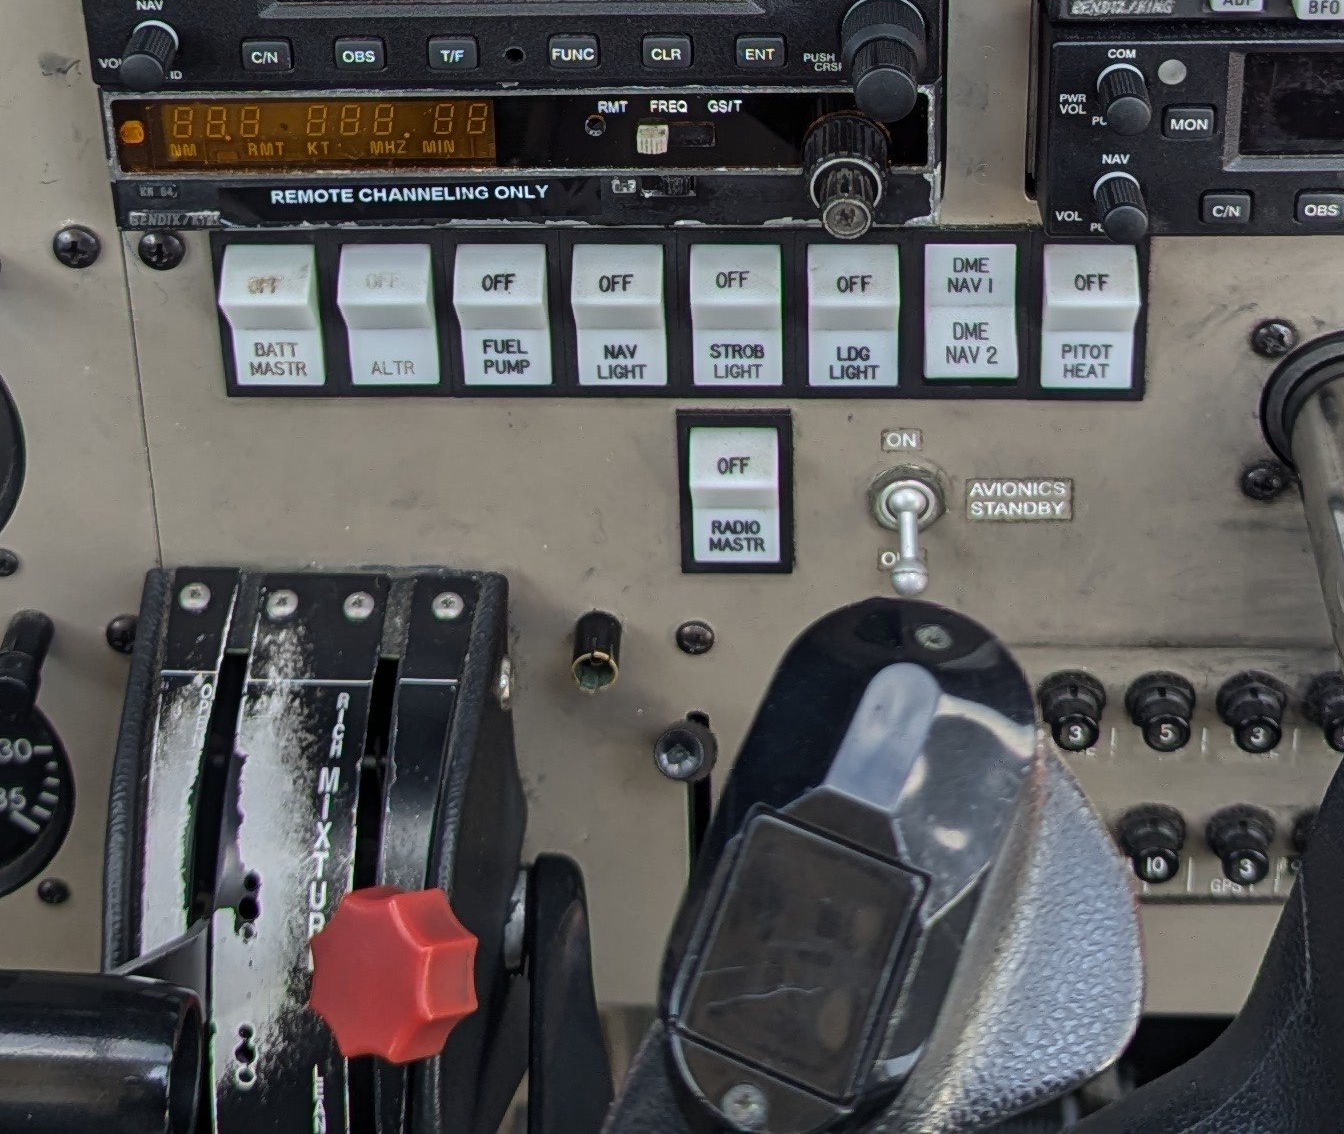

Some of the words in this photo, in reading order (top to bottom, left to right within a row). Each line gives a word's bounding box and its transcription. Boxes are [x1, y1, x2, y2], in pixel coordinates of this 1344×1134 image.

[1308, 0, 1340, 16] BFO
[251, 51, 279, 64] C/N
[342, 49, 376, 63] OBS
[597, 100, 629, 114] RMT
[649, 100, 688, 114] FREQ
[271, 187, 355, 205] REMOTE
[359, 186, 489, 203] CHANNELING
[494, 185, 549, 200] ONLY
[481, 273, 516, 292] OFF
[953, 323, 990, 341] DME
[254, 342, 299, 358] BATT
[483, 338, 528, 355] FUEL
[709, 344, 765, 360] STROB
[836, 346, 871, 363] LDG
[1061, 344, 1113, 360] PITOT
[945, 346, 981, 365] NAV
[986, 346, 998, 365] 2
[249, 360, 308, 378] MASTR
[371, 360, 416, 376] ALTR
[484, 359, 530, 375] PUMP
[829, 364, 879, 381] LIGHT
[1063, 363, 1110, 380] HEAT
[886, 432, 916, 448] ON
[969, 481, 1066, 497] AVIONICS
[969, 500, 1065, 517] STANDBY
[711, 519, 761, 536] RADIO
[708, 536, 765, 553] MASTR
[328, 691, 350, 759] RICH
